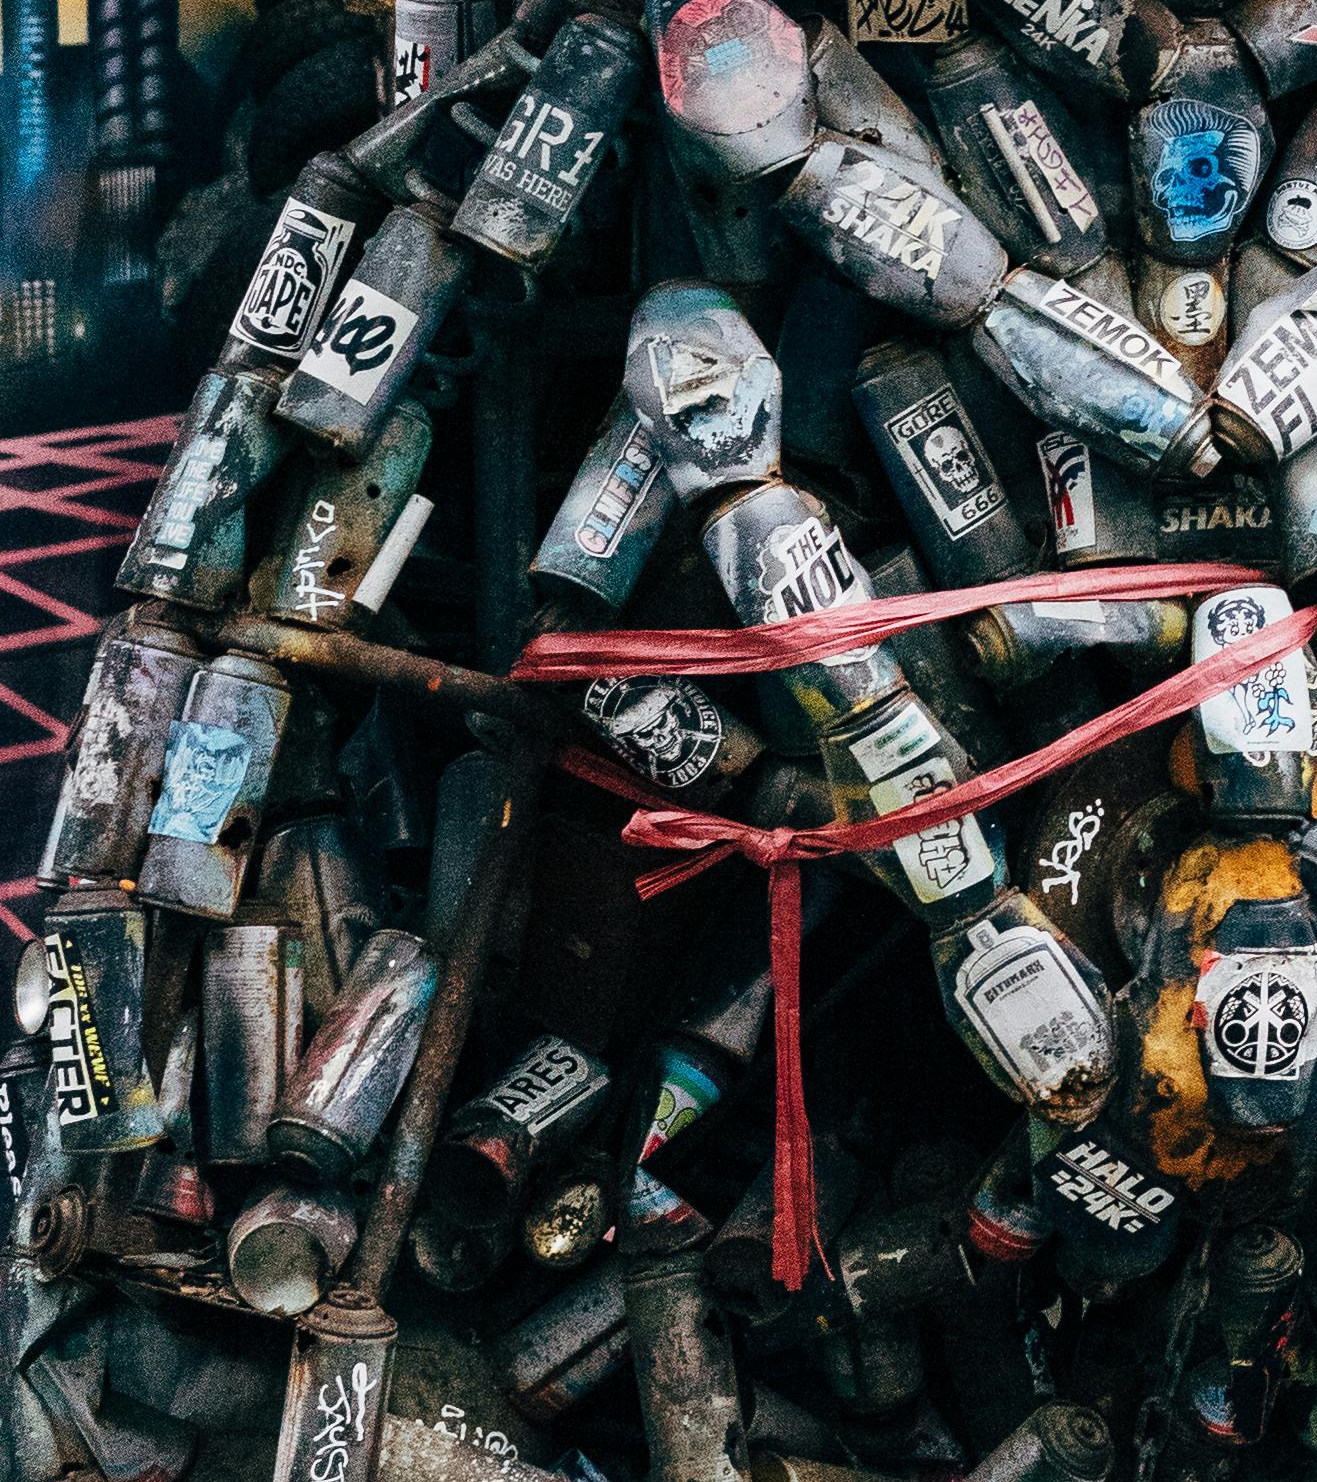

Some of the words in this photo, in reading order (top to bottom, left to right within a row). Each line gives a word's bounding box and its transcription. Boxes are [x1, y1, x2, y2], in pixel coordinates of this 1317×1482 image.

[1019, 22, 1055, 53] 24K
[516, 168, 573, 212] HERE
[836, 158, 963, 257] 24K
[822, 195, 946, 281] SHAKA
[1048, 287, 1179, 380] ZEMOK
[898, 392, 956, 439] GORE
[961, 486, 1002, 523] 666
[786, 524, 821, 571] THE
[667, 752, 708, 786] 2003
[1066, 1140, 1175, 1215] HALO
